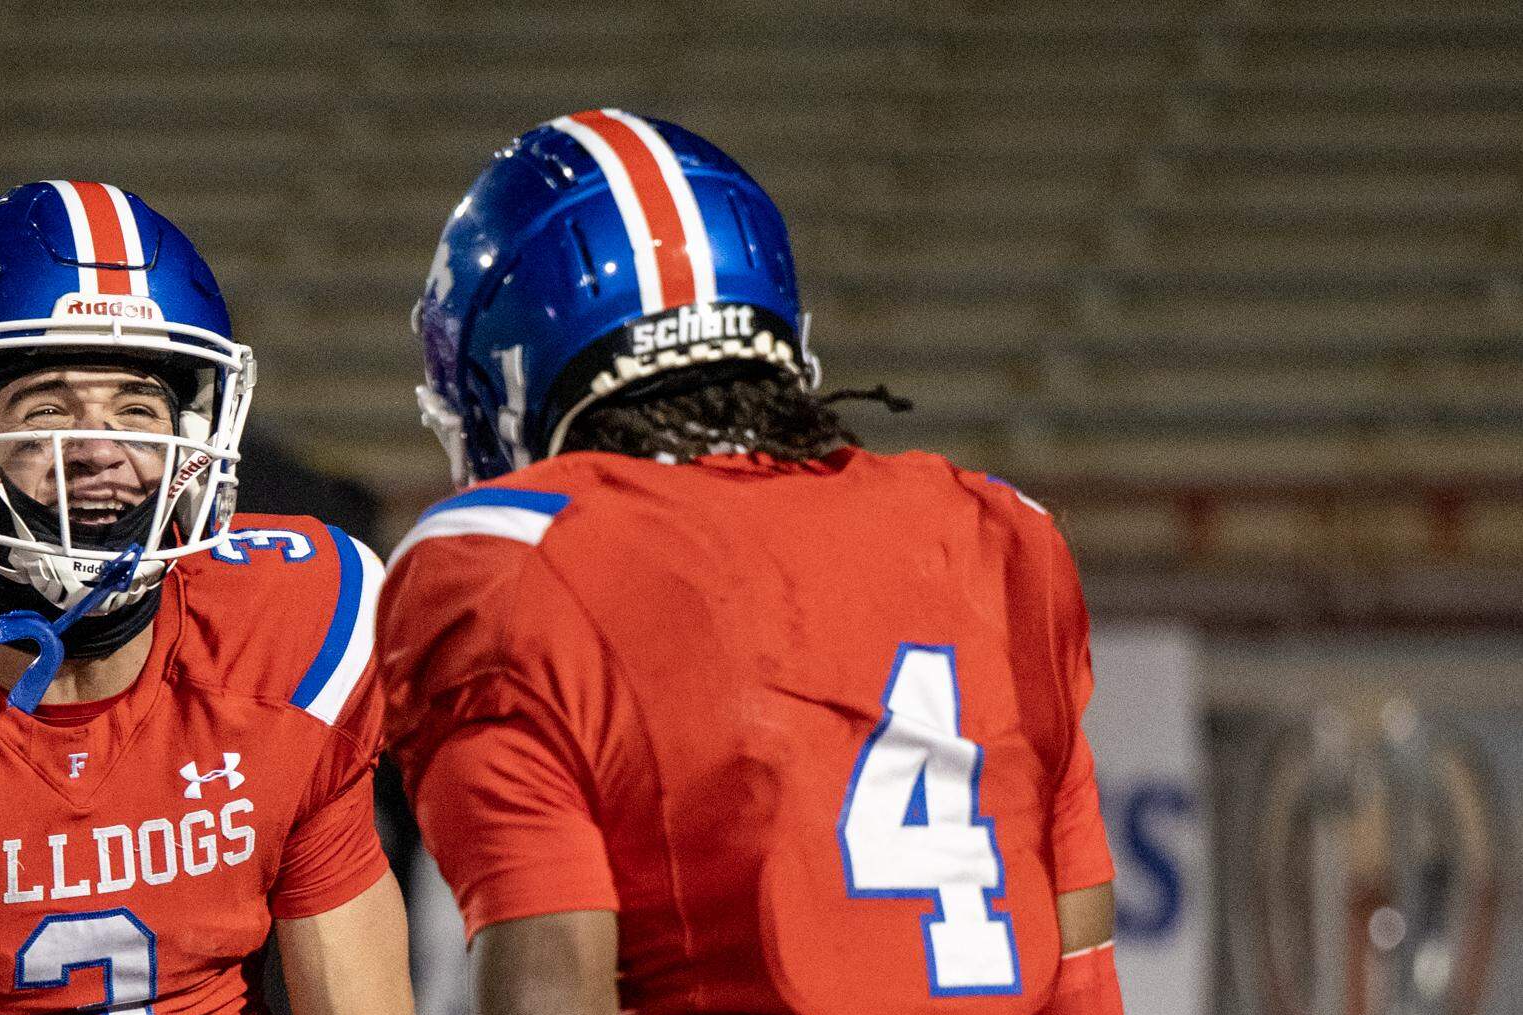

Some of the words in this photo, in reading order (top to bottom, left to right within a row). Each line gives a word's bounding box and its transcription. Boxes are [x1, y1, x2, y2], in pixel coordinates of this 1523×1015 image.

[210, 528, 317, 565] 3
[73, 561, 103, 575] Ridd
[68, 752, 89, 779] F
[836, 641, 1023, 998] 4
